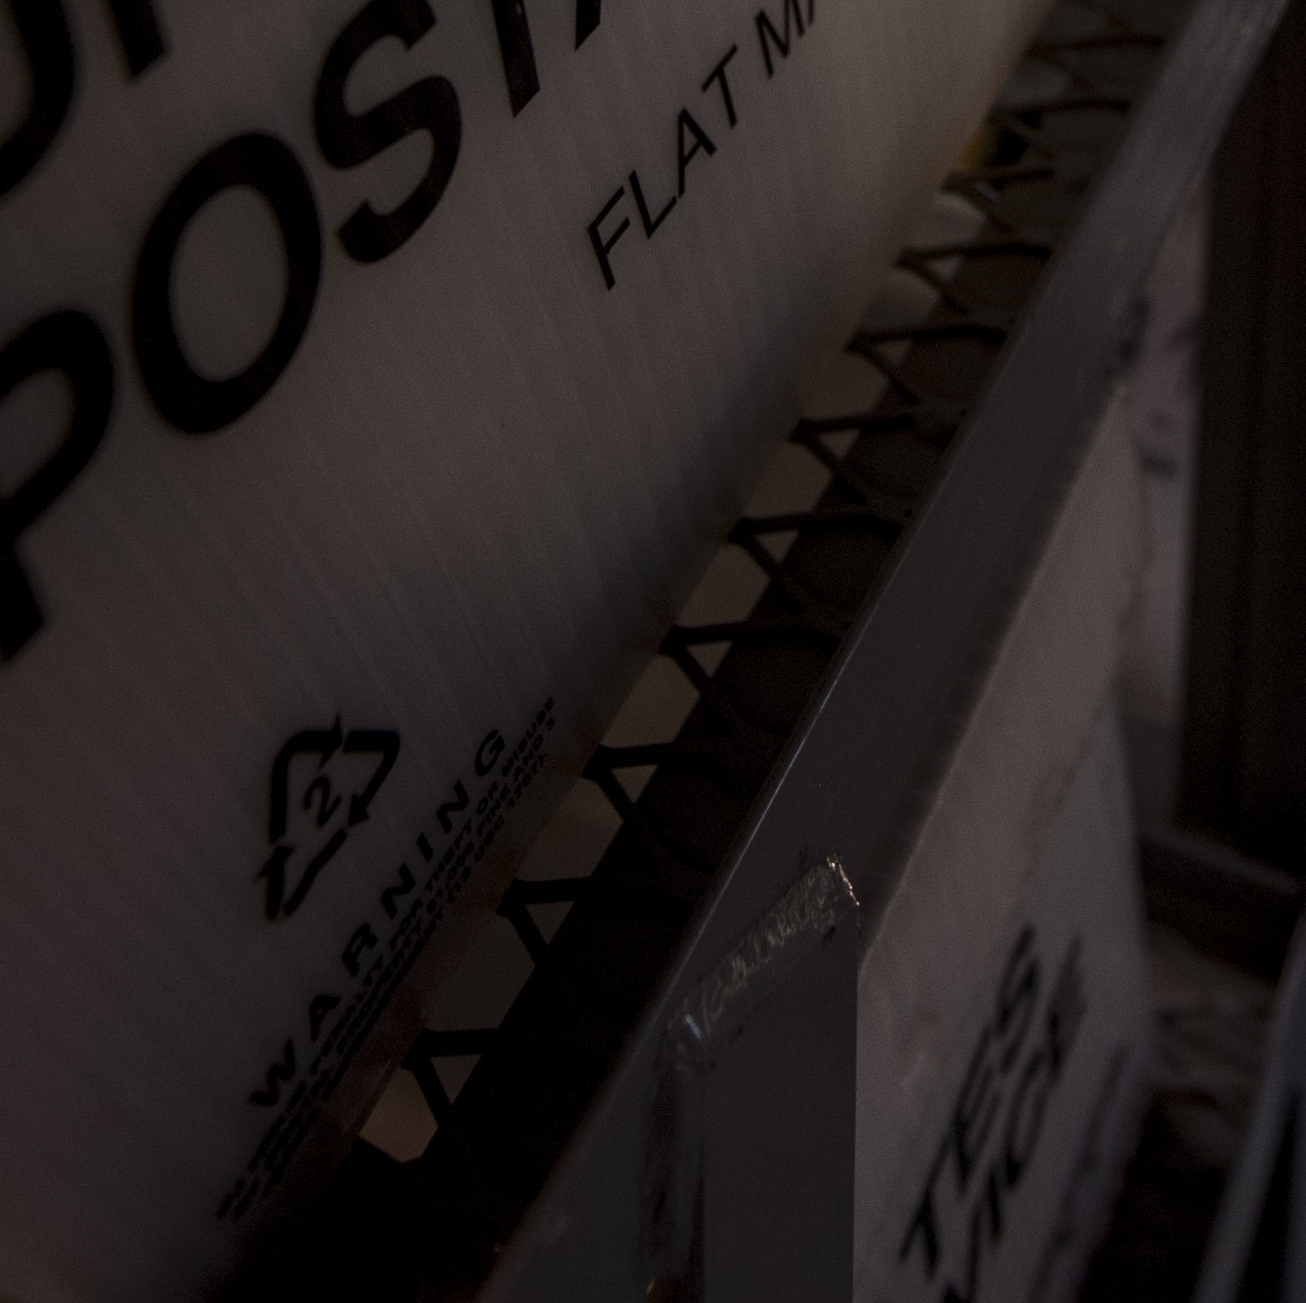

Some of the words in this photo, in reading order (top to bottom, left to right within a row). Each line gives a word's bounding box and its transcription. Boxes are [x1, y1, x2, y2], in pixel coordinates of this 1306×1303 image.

[586, 46, 740, 291] FLAT
[249, 728, 506, 1108] WARNING
[389, 897, 423, 950] FOR
[424, 818, 471, 893] THEFT
[477, 781, 498, 815] OR
